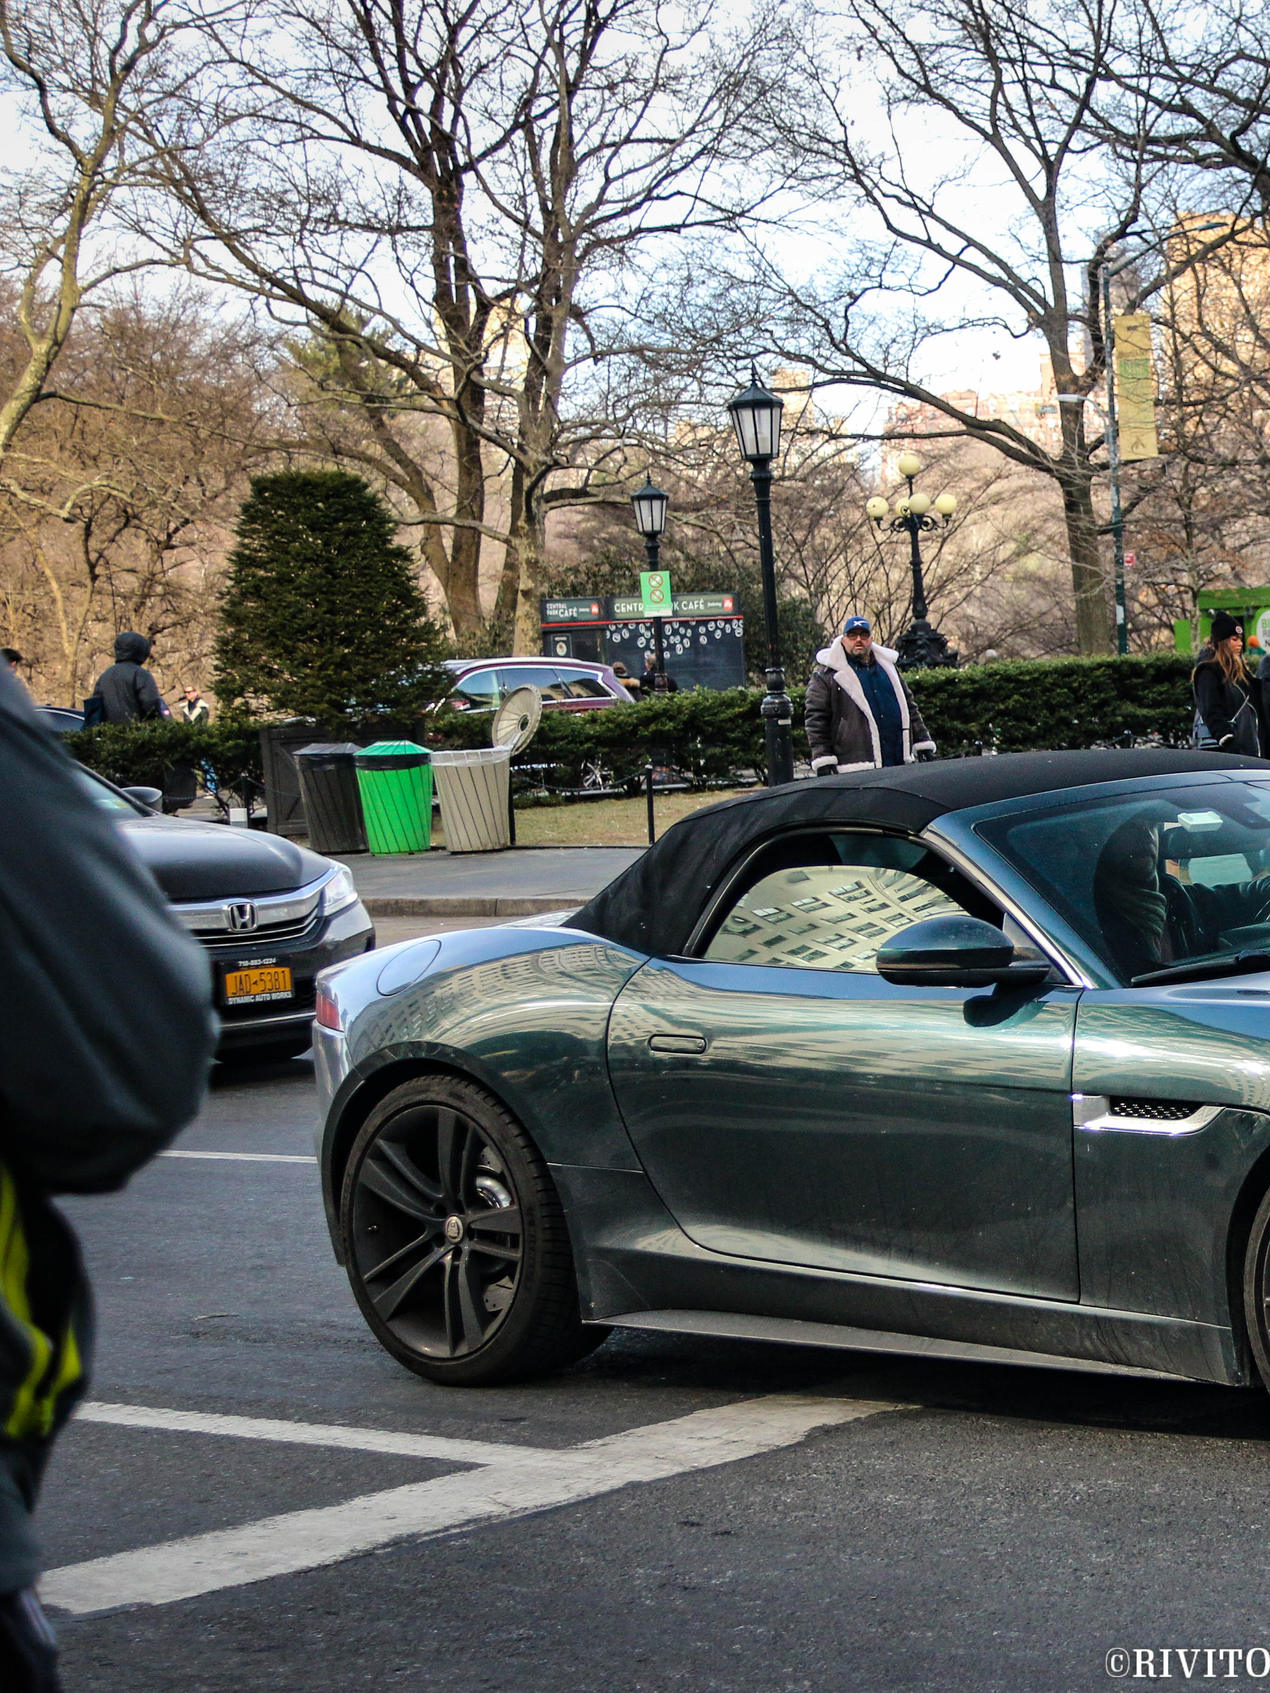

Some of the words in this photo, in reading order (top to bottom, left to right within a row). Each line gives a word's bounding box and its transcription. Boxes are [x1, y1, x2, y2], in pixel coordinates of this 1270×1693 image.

[614, 602, 644, 613] CENTR
[681, 598, 705, 610] CAFÉ
[558, 606, 578, 618] CAFÉ
[255, 993, 271, 1002] AUTO
[271, 991, 293, 1000] WORKS
